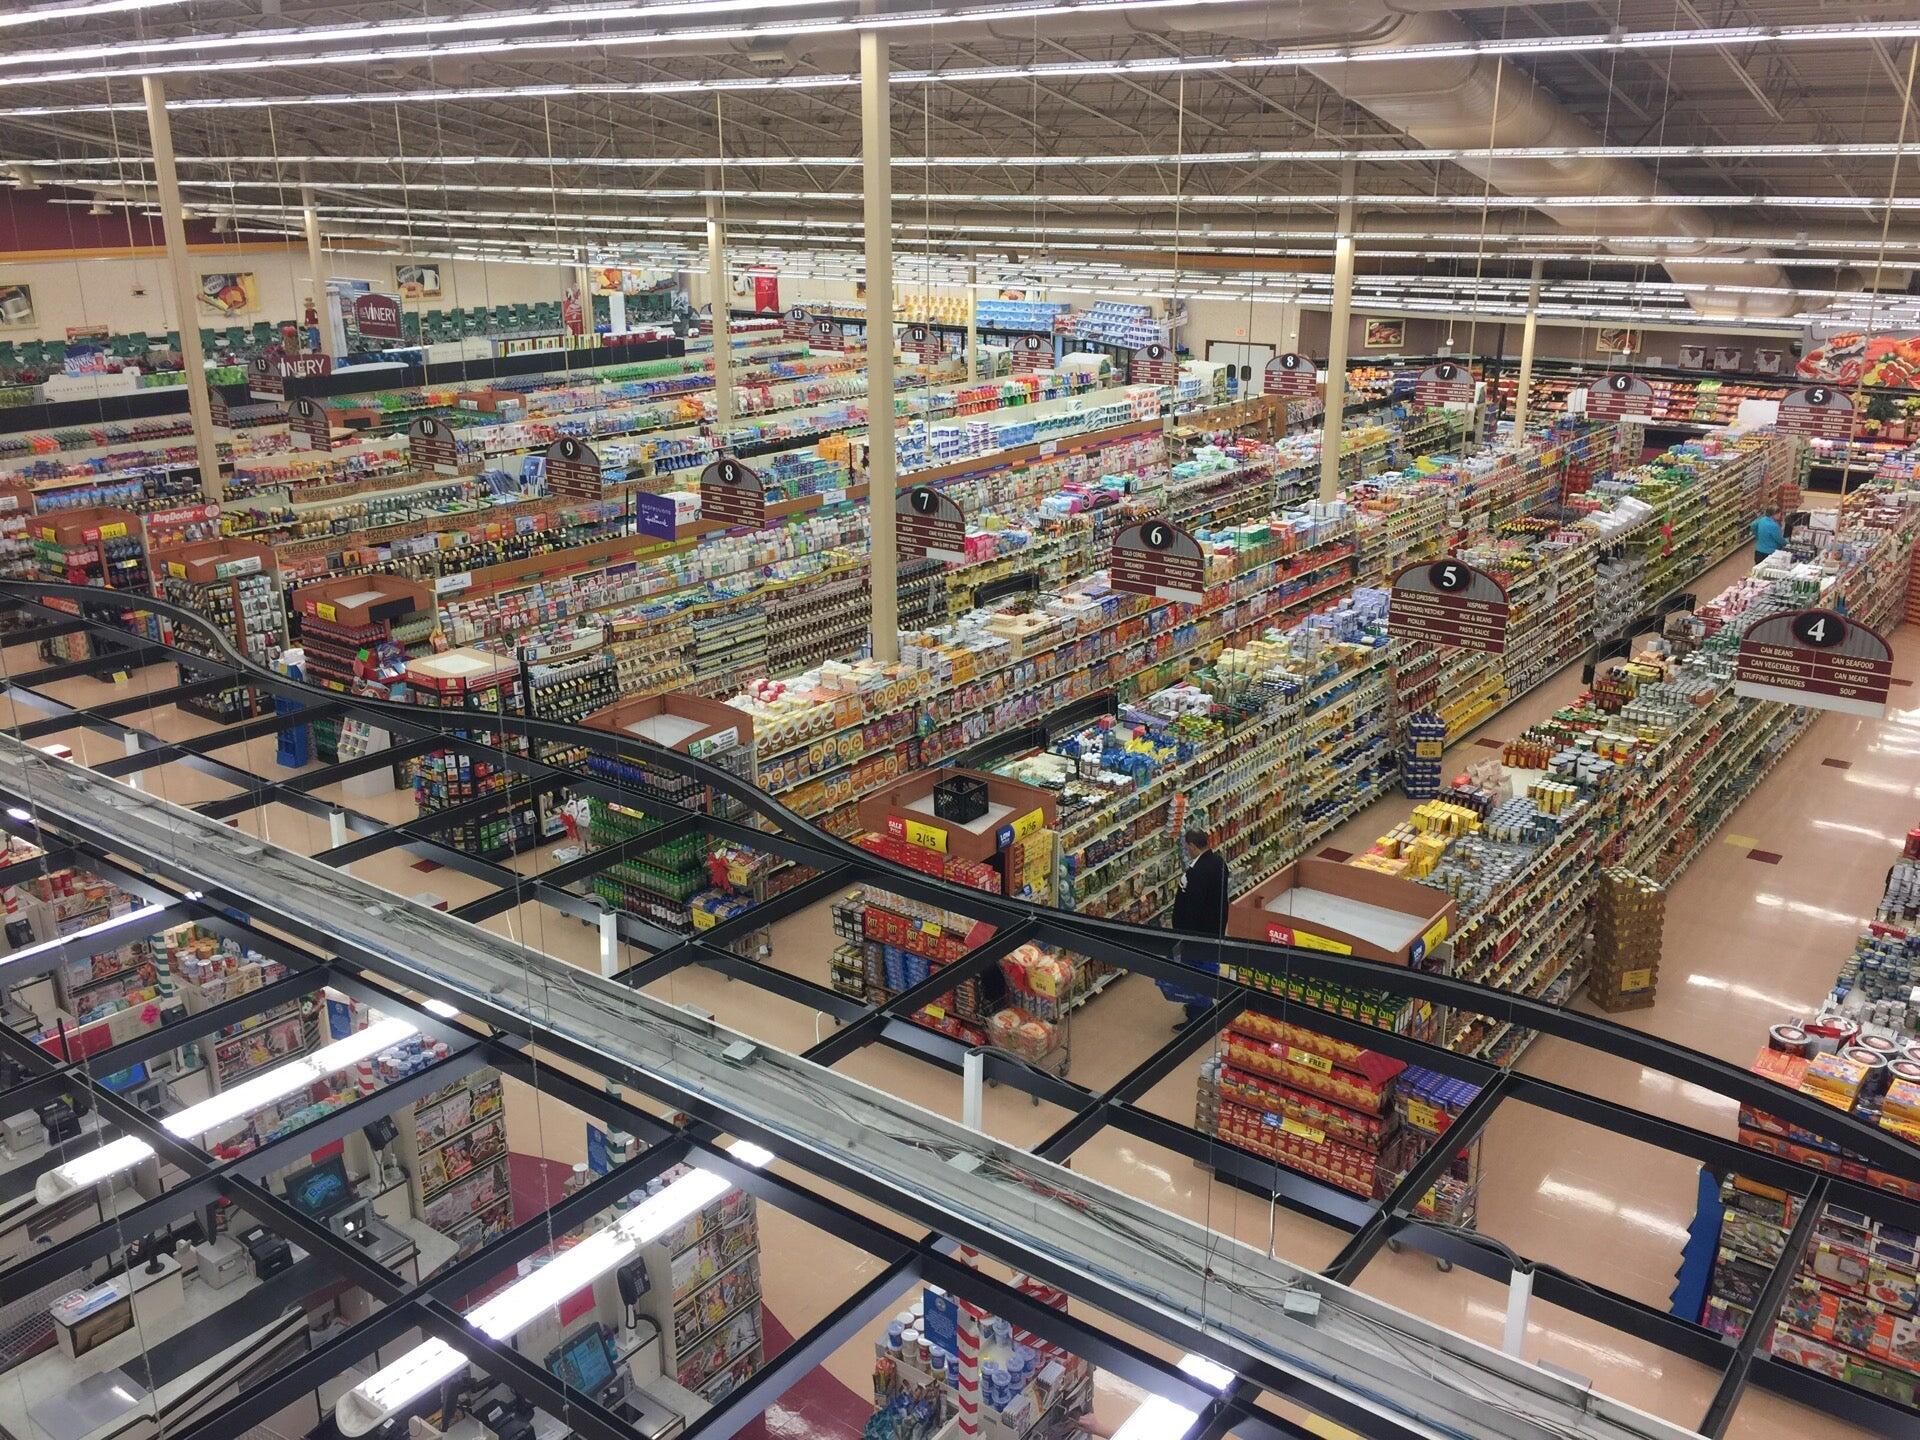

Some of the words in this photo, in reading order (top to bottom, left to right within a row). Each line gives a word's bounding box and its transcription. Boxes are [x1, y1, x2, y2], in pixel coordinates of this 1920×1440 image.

[365, 303, 396, 322] VINERY
[794, 310, 802, 319] 13
[821, 323, 830, 333] 12
[915, 329, 923, 339] 11
[1028, 338, 1037, 348] 10
[1152, 346, 1159, 357] 9
[257, 359, 266, 371] 13
[1287, 355, 1294, 367] 8
[1442, 366, 1450, 378] 7
[1616, 376, 1626, 388] 6
[1813, 389, 1824, 402] 5
[300, 402, 309, 415] 11
[422, 420, 433, 434] 10
[566, 441, 574, 456] 9
[725, 464, 734, 481] 8
[920, 492, 929, 510] 7
[1151, 526, 1162, 545] 6
[1442, 566, 1457, 587] 5
[1400, 591, 1416, 599] SALAD
[1407, 618, 1426, 626] PICKLES
[1476, 616, 1492, 624] BEANS
[1407, 629, 1424, 638] BUTTER
[1459, 626, 1474, 634] PASTA
[1474, 628, 1490, 637] SAUCE
[1807, 618, 1826, 642] 4
[550, 643, 572, 655] Spices
[1471, 640, 1486, 649] PASTA
[1760, 646, 1773, 654] CAN
[1773, 648, 1794, 658] BEANS
[1751, 659, 1763, 668] CAN
[1764, 660, 1800, 673] VEGETABLES
[1831, 657, 1845, 665] CAN
[1845, 659, 1875, 670] SEAFOOD
[1742, 672, 1769, 683] STUFFING
[1776, 677, 1806, 688] POTATOES
[1834, 672, 1848, 680] CAN
[1848, 673, 1869, 684] MEATS
[1840, 687, 1857, 696] SOUP
[888, 821, 903, 830] SALE
[1268, 929, 1289, 941] SALE
[1308, 1057, 1327, 1069] FREE
